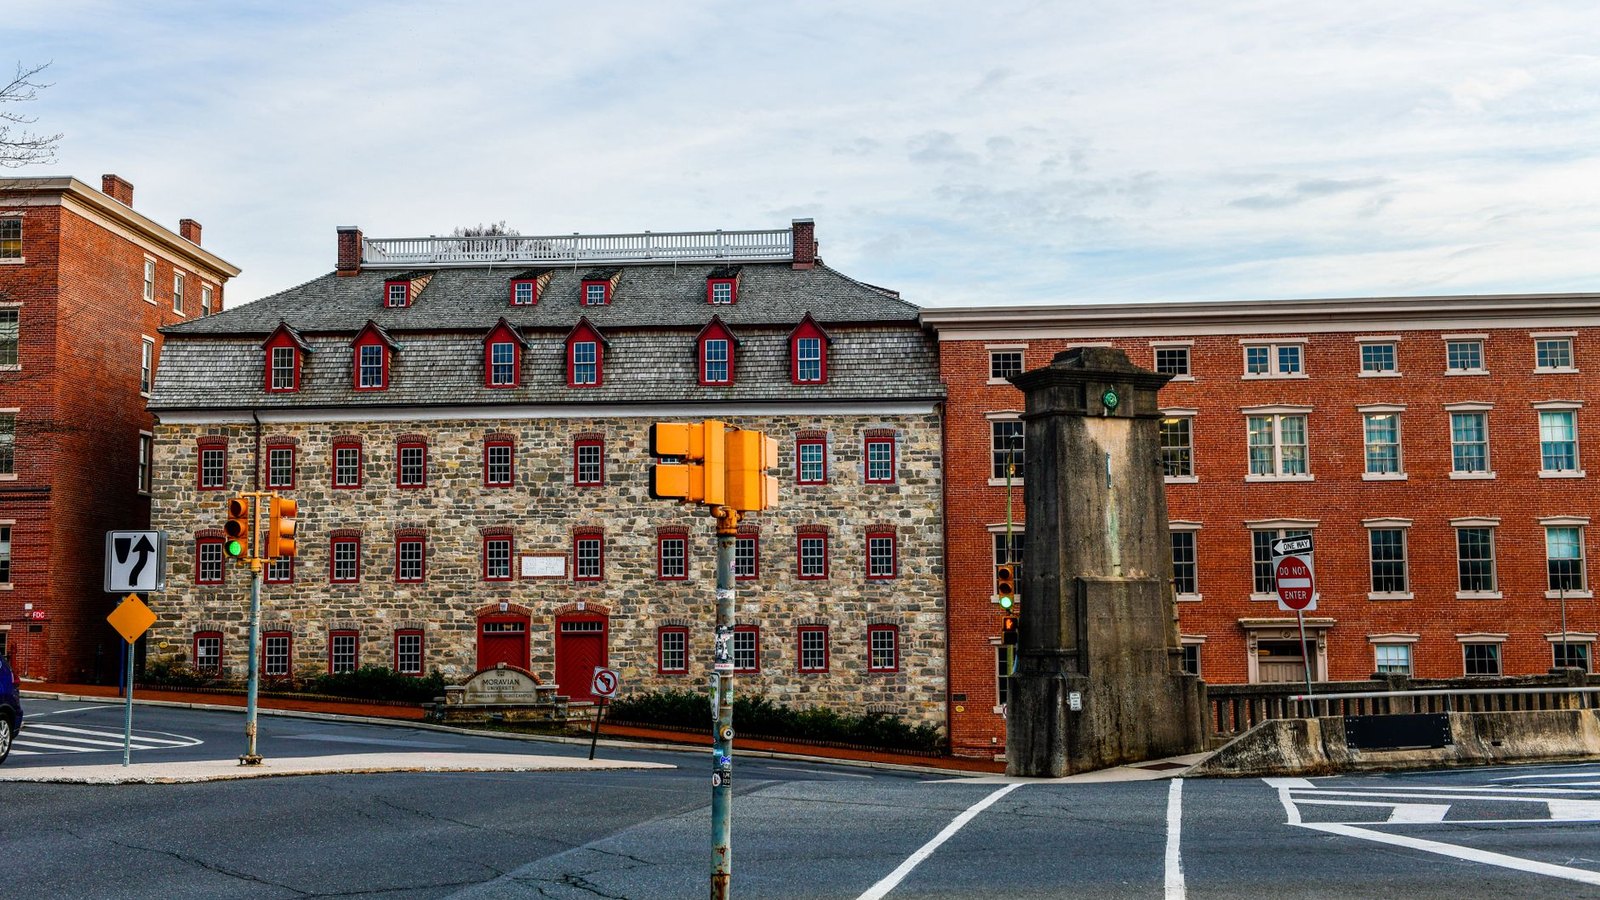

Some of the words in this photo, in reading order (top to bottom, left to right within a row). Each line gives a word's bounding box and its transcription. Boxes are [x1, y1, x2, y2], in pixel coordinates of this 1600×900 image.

[1283, 542, 1295, 551] ONE
[1296, 539, 1309, 549] WAY
[1279, 566, 1289, 576] DO
[1292, 566, 1307, 576] NOT
[1284, 590, 1307, 600] ENTER
[482, 678, 520, 686] MORAVIAN
